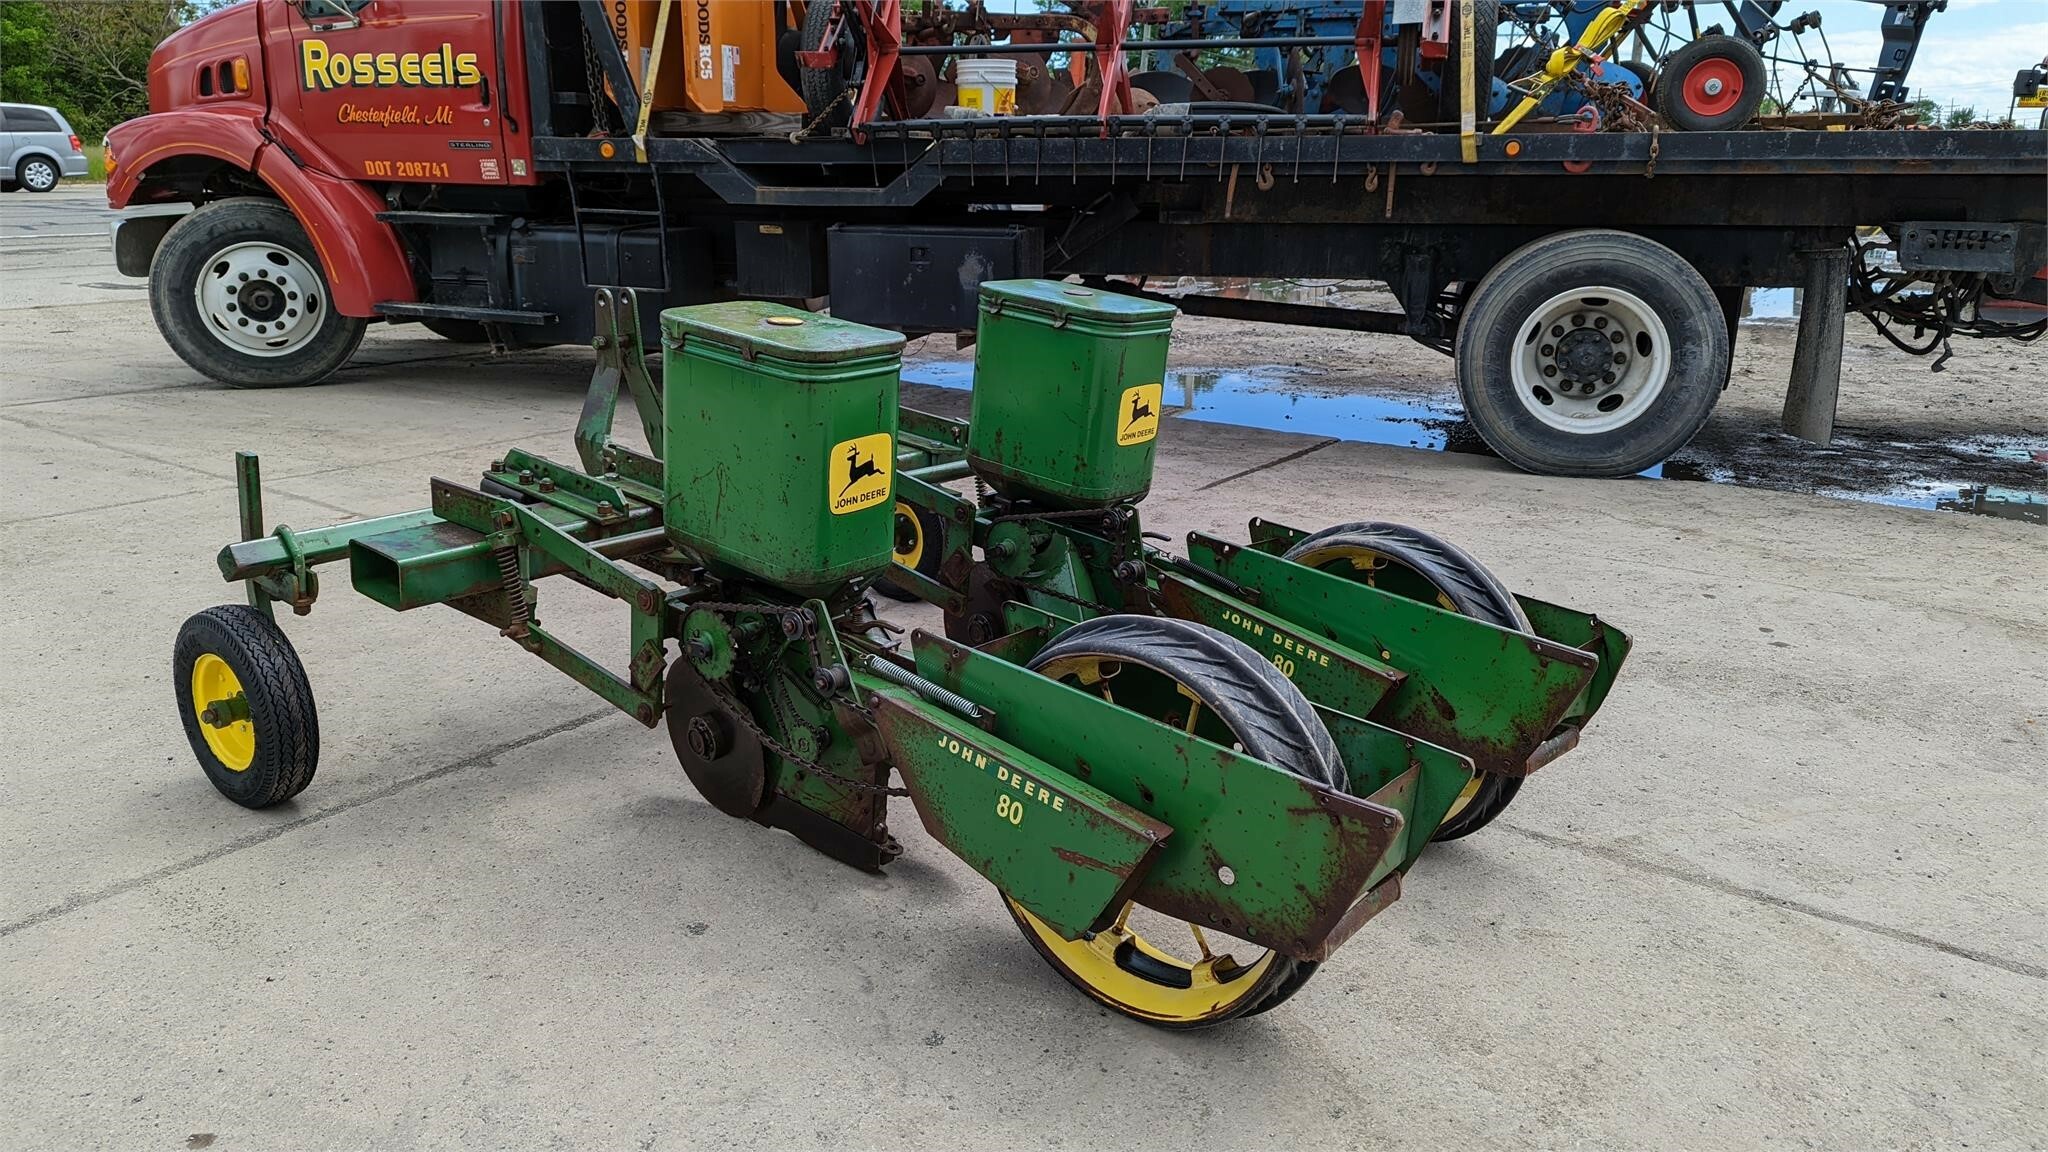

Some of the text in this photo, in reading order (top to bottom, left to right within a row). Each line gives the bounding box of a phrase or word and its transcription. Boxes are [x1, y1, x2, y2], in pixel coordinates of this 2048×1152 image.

[302, 39, 481, 89] Rosseels
[699, 44, 713, 80] RC5
[338, 103, 453, 127] Chesterfield, Mi
[364, 160, 449, 178] DOT 208741
[1120, 428, 1155, 442] JOHN DEERE
[834, 487, 887, 509] JOHN DEERE
[1222, 610, 1330, 667] JOHN DEERE
[1273, 654, 1295, 678] 80
[938, 735, 1065, 812] JOHN DEERE
[996, 794, 1023, 825] 80
